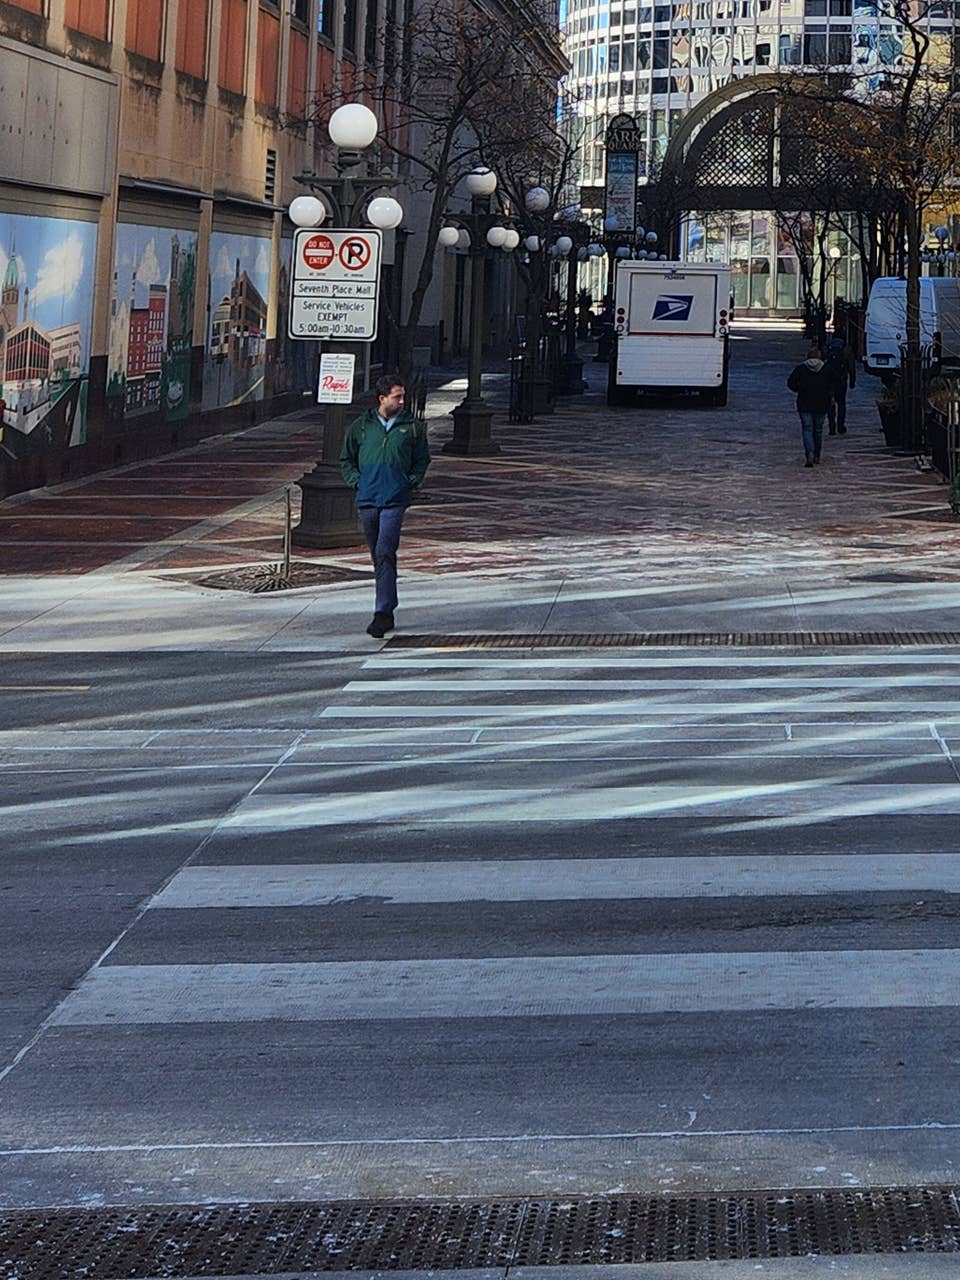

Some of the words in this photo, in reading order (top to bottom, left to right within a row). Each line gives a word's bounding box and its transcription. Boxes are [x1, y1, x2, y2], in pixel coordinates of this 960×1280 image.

[309, 257, 328, 265] ENTER
[299, 284, 329, 293] Seventh
[332, 284, 353, 294] Place
[356, 285, 372, 295] Mall
[303, 301, 331, 310] Service
[335, 302, 365, 311] Vehicles
[317, 312, 348, 321] EXEMPT
